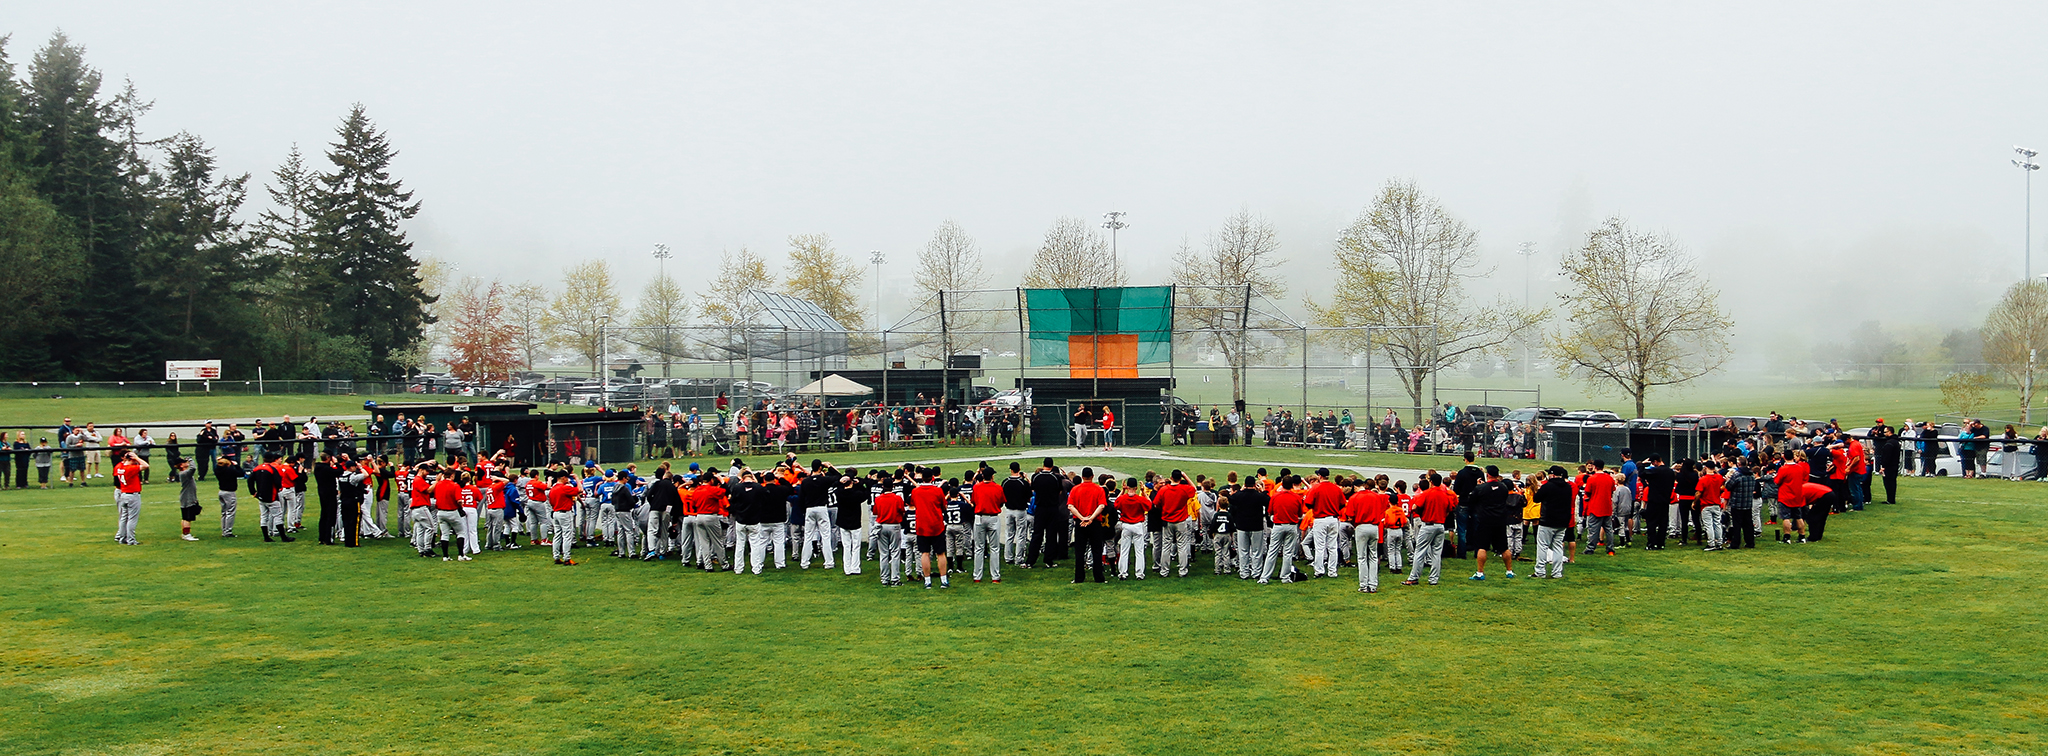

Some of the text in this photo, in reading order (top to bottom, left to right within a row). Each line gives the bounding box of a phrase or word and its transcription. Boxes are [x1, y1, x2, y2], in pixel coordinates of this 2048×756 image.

[1402, 503, 1409, 516] 8
[947, 511, 961, 524] 13
[1395, 517, 1402, 528] 4
[1218, 523, 1227, 533] 4
